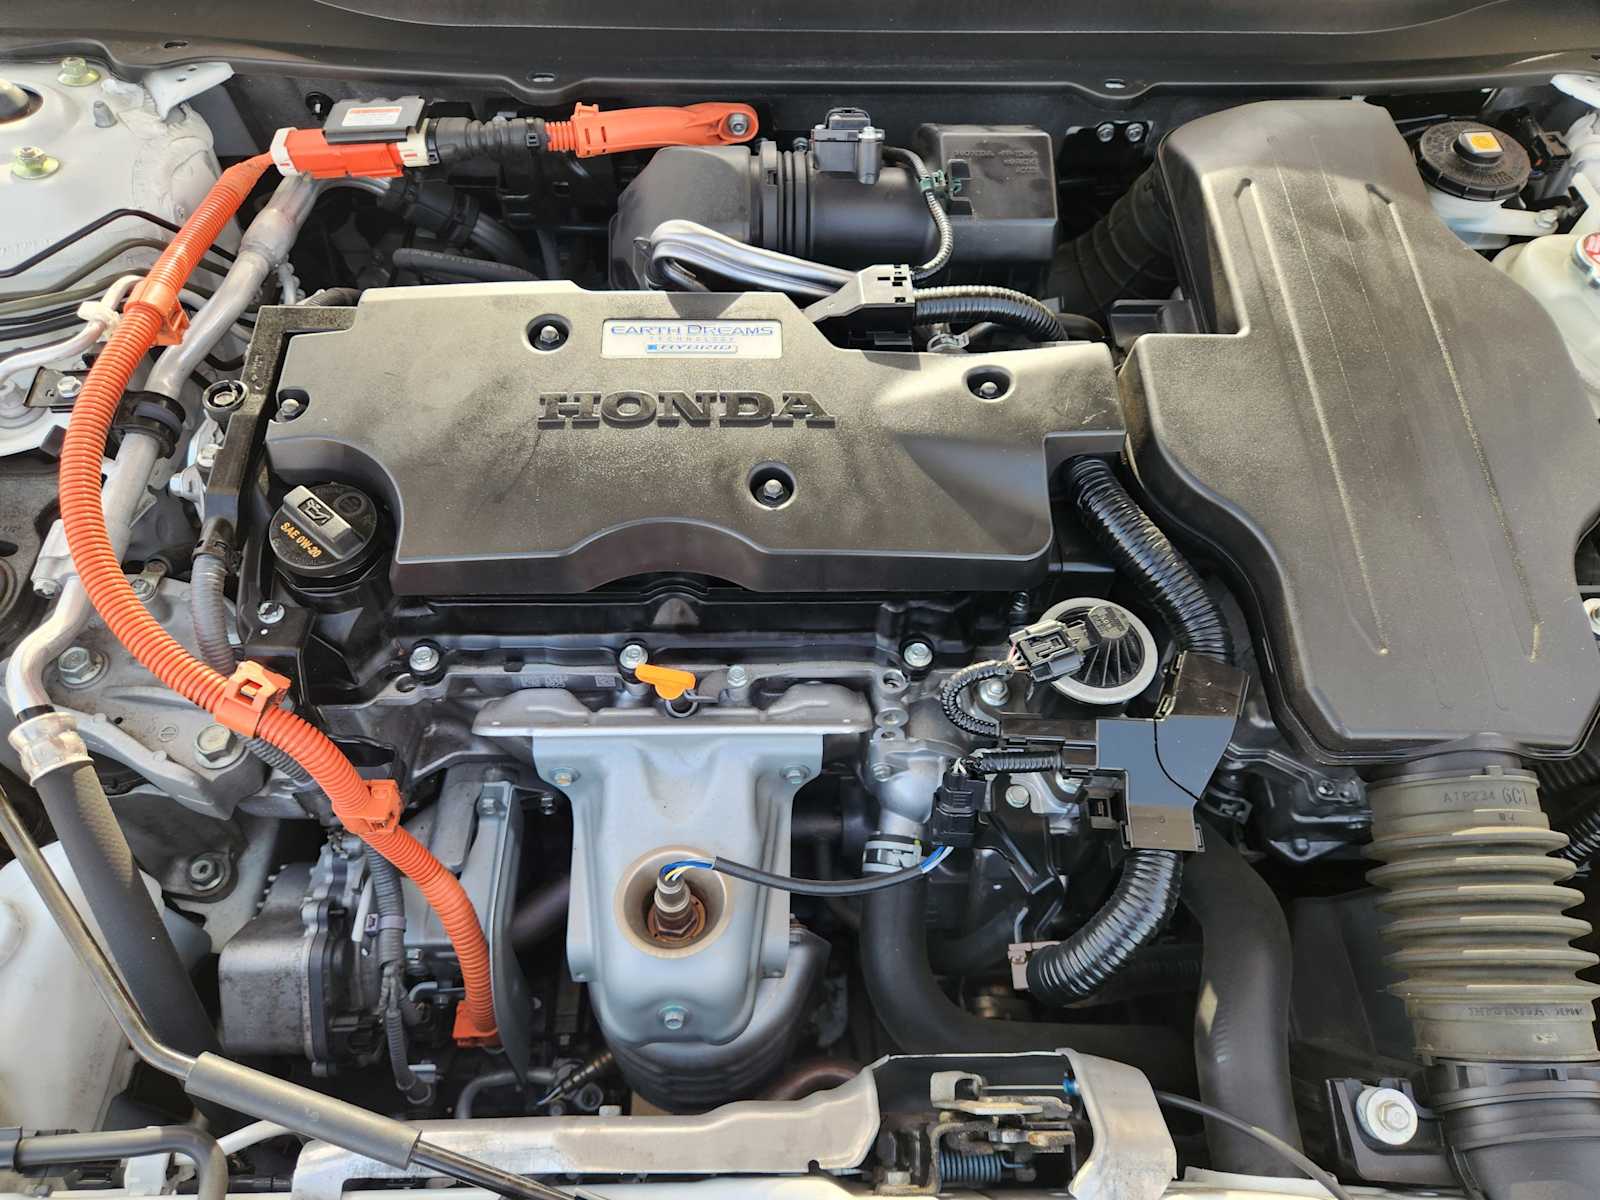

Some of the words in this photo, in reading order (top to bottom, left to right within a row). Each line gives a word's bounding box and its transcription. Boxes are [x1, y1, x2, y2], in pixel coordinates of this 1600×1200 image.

[611, 325, 681, 336] EARTH
[687, 324, 774, 337] DREAMS
[537, 391, 836, 430] HONDA
[280, 521, 301, 540] SAE
[296, 535, 322, 558] 0W-20
